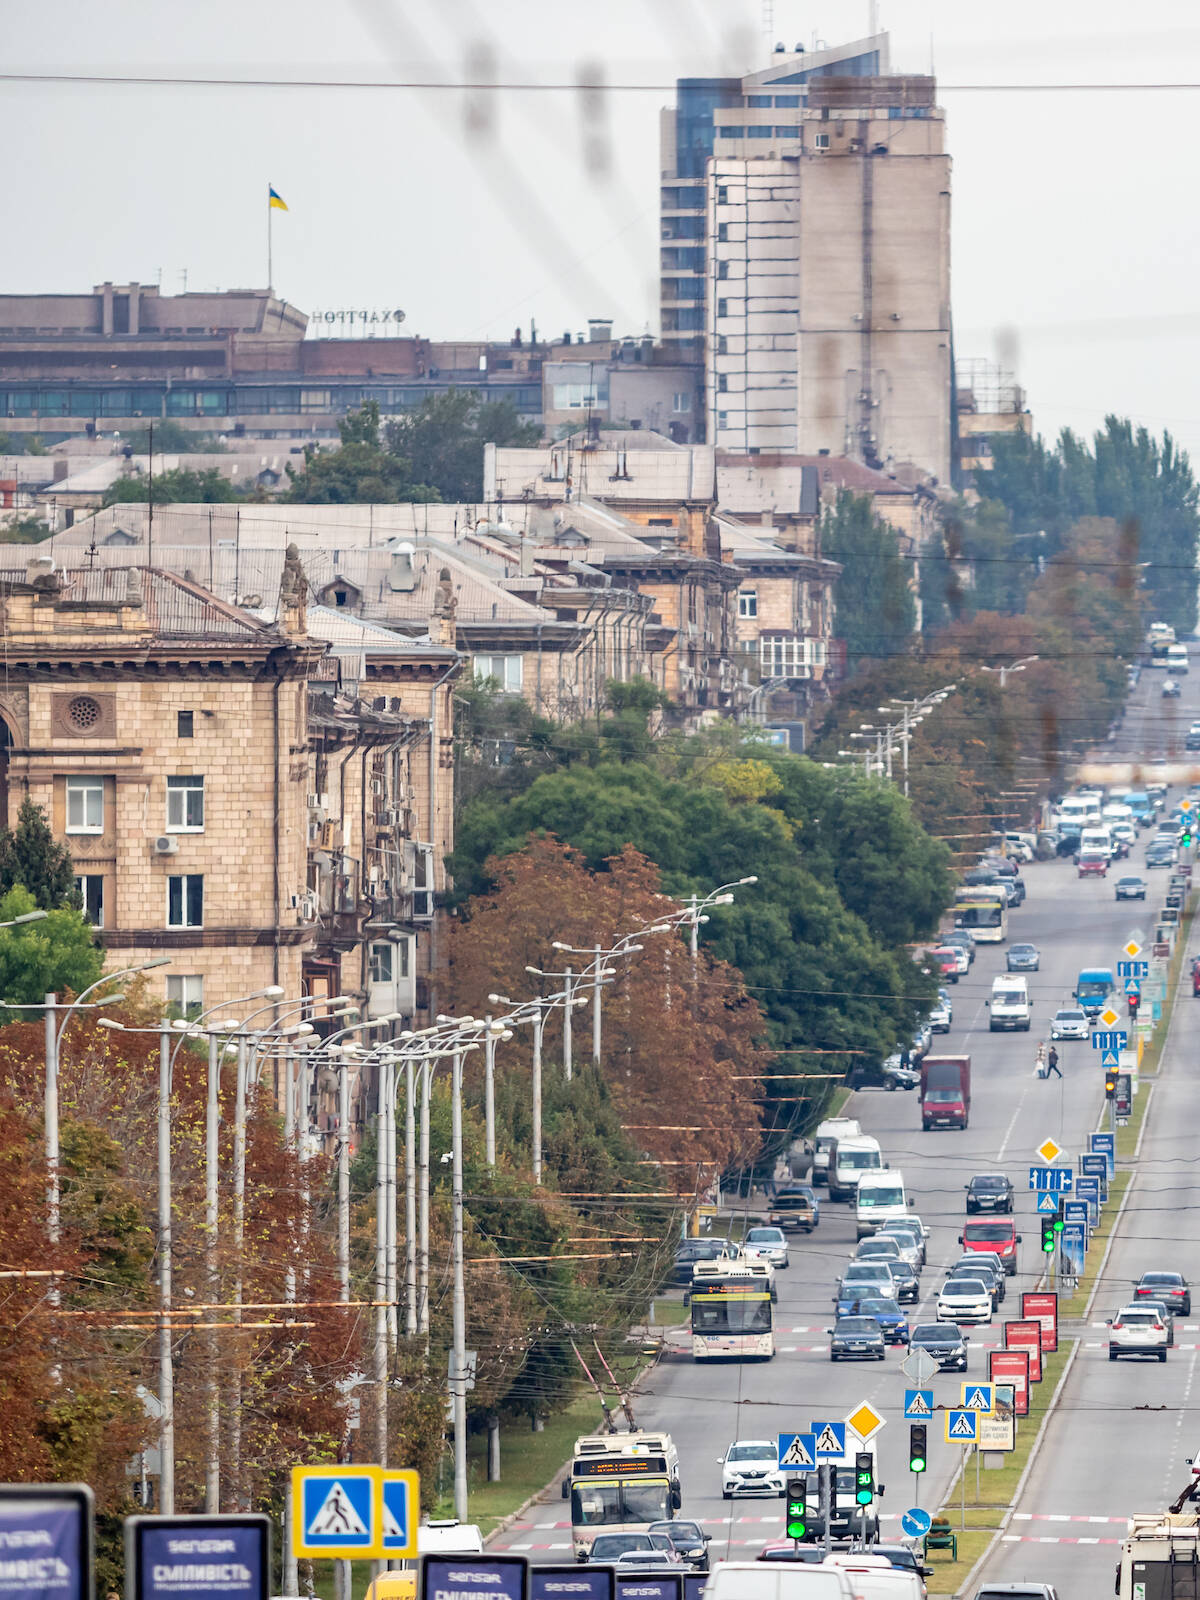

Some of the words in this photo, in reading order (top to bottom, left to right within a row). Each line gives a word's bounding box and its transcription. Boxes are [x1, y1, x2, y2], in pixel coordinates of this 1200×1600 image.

[858, 1473, 871, 1486] 30
[789, 1502, 804, 1517] 30
[153, 1564, 252, 1581] СМІЛИВІСТЬ
